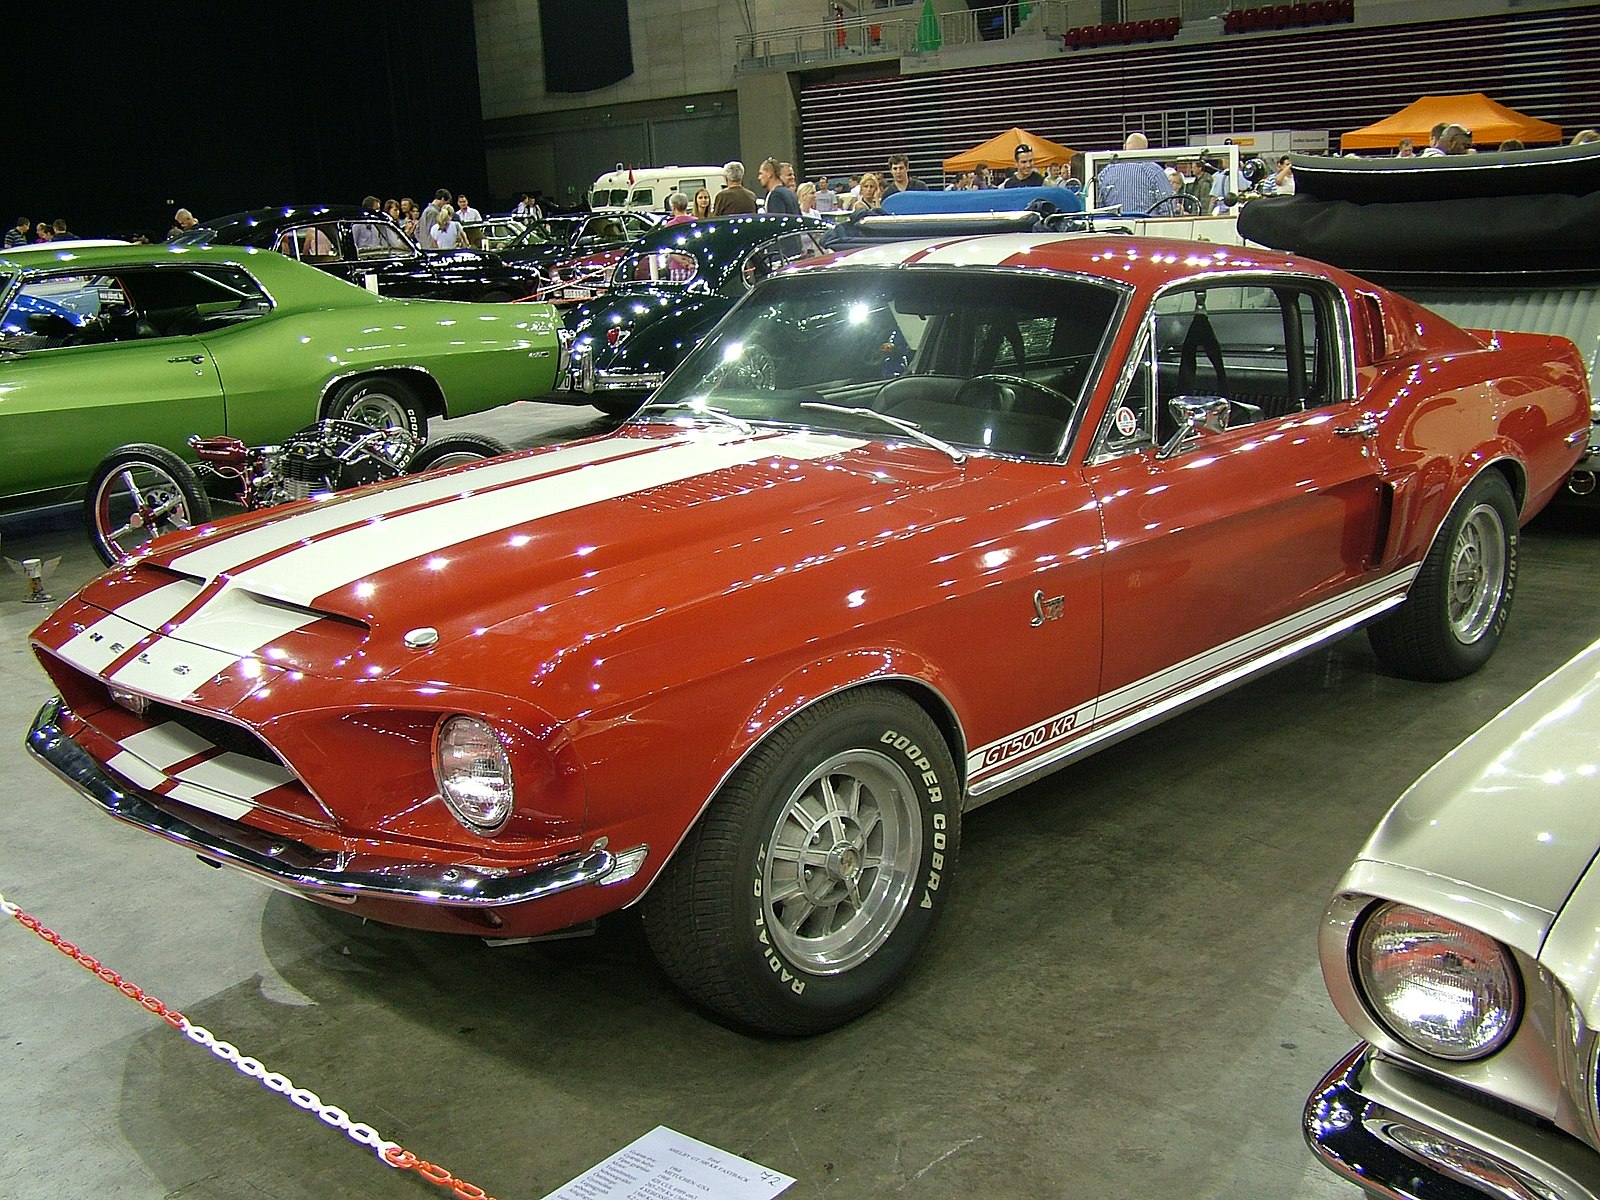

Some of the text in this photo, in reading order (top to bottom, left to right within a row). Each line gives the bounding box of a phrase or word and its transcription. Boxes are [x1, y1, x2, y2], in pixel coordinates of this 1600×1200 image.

[408, 409, 418, 453] COOPR
[1504, 535, 1517, 602] RADIAL
[985, 713, 1078, 766] GT500 KR
[880, 729, 947, 910] COOPER COBRA
[753, 843, 806, 995] RADIAL G/T
[664, 1169, 696, 1186] METUCHEN
[718, 1166, 750, 1183] FASTBACK
[760, 1171, 781, 1188] 72
